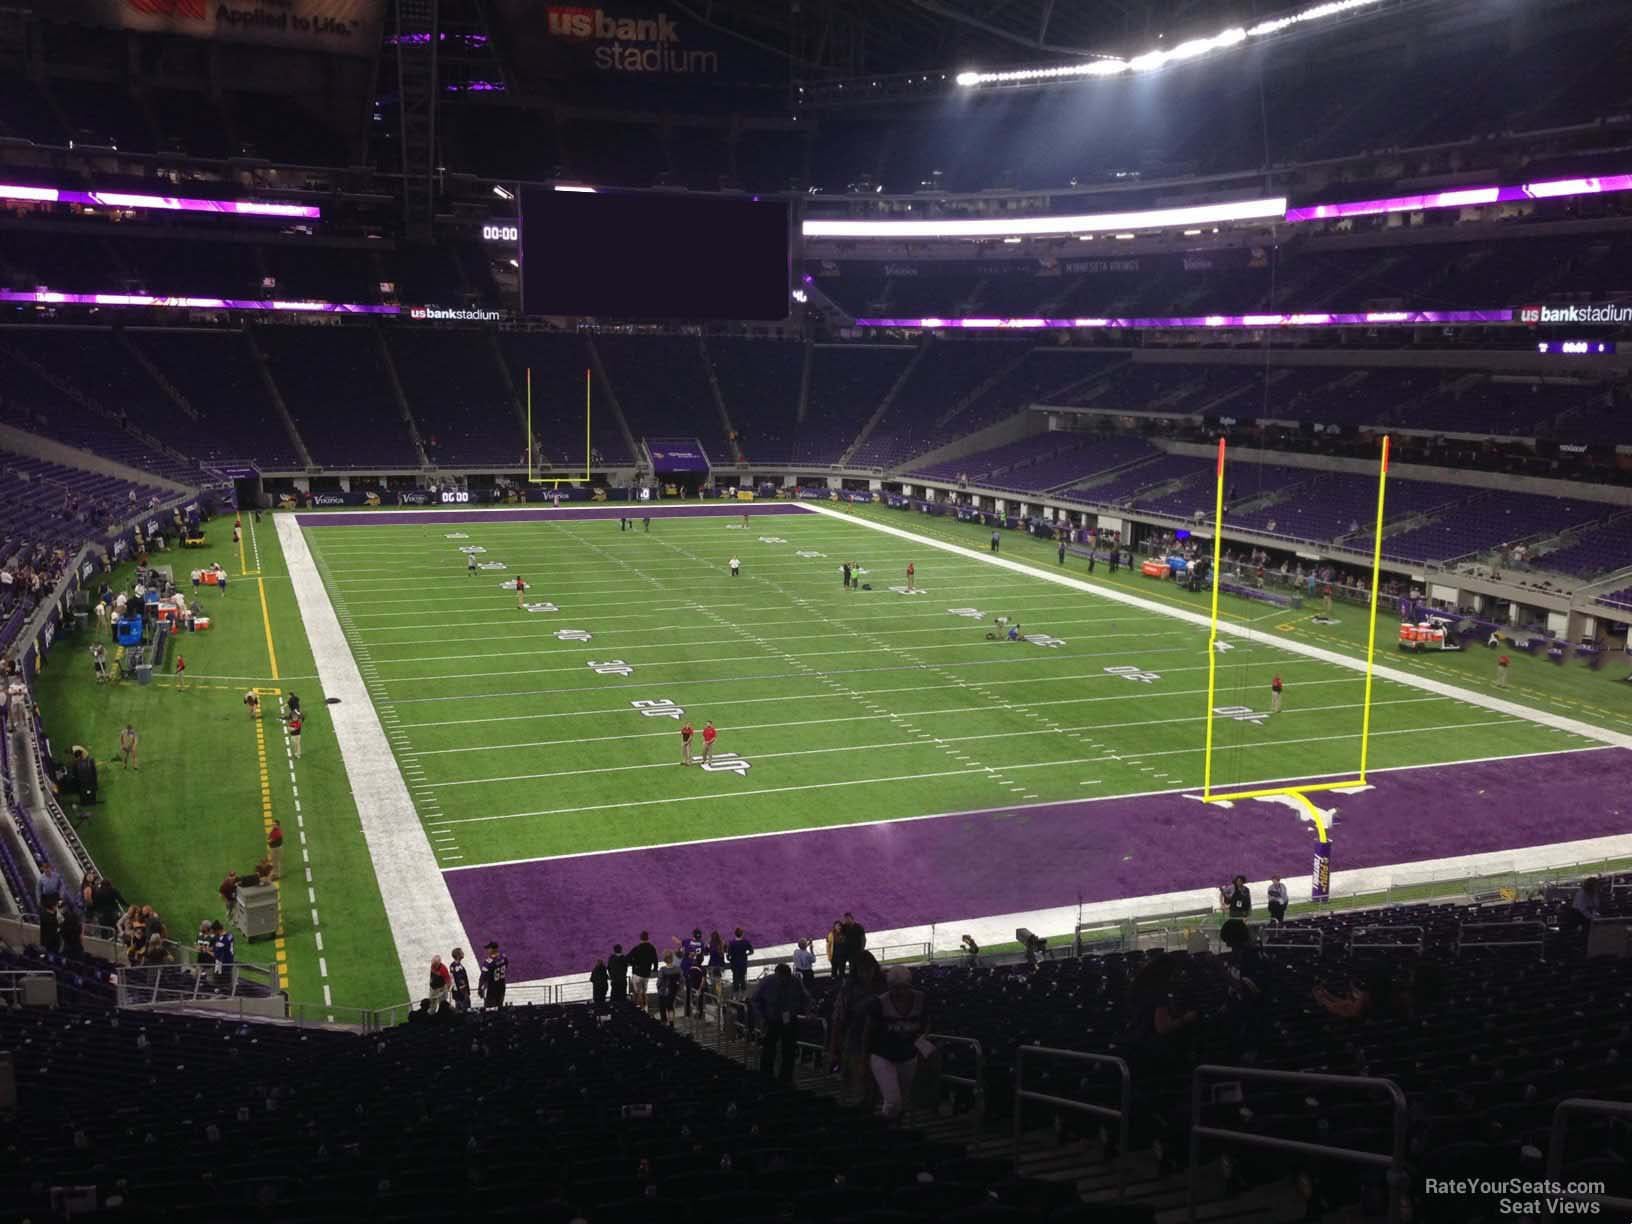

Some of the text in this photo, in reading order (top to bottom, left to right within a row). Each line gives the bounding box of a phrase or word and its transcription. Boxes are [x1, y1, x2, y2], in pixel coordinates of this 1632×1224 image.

[215, 4, 287, 31] Applied
[292, 15, 310, 30] to
[594, 41, 719, 72] stadium
[483, 226, 518, 240] 00:00
[586, 659, 634, 674] 30
[1103, 665, 1162, 682] 20
[630, 698, 686, 718] 20
